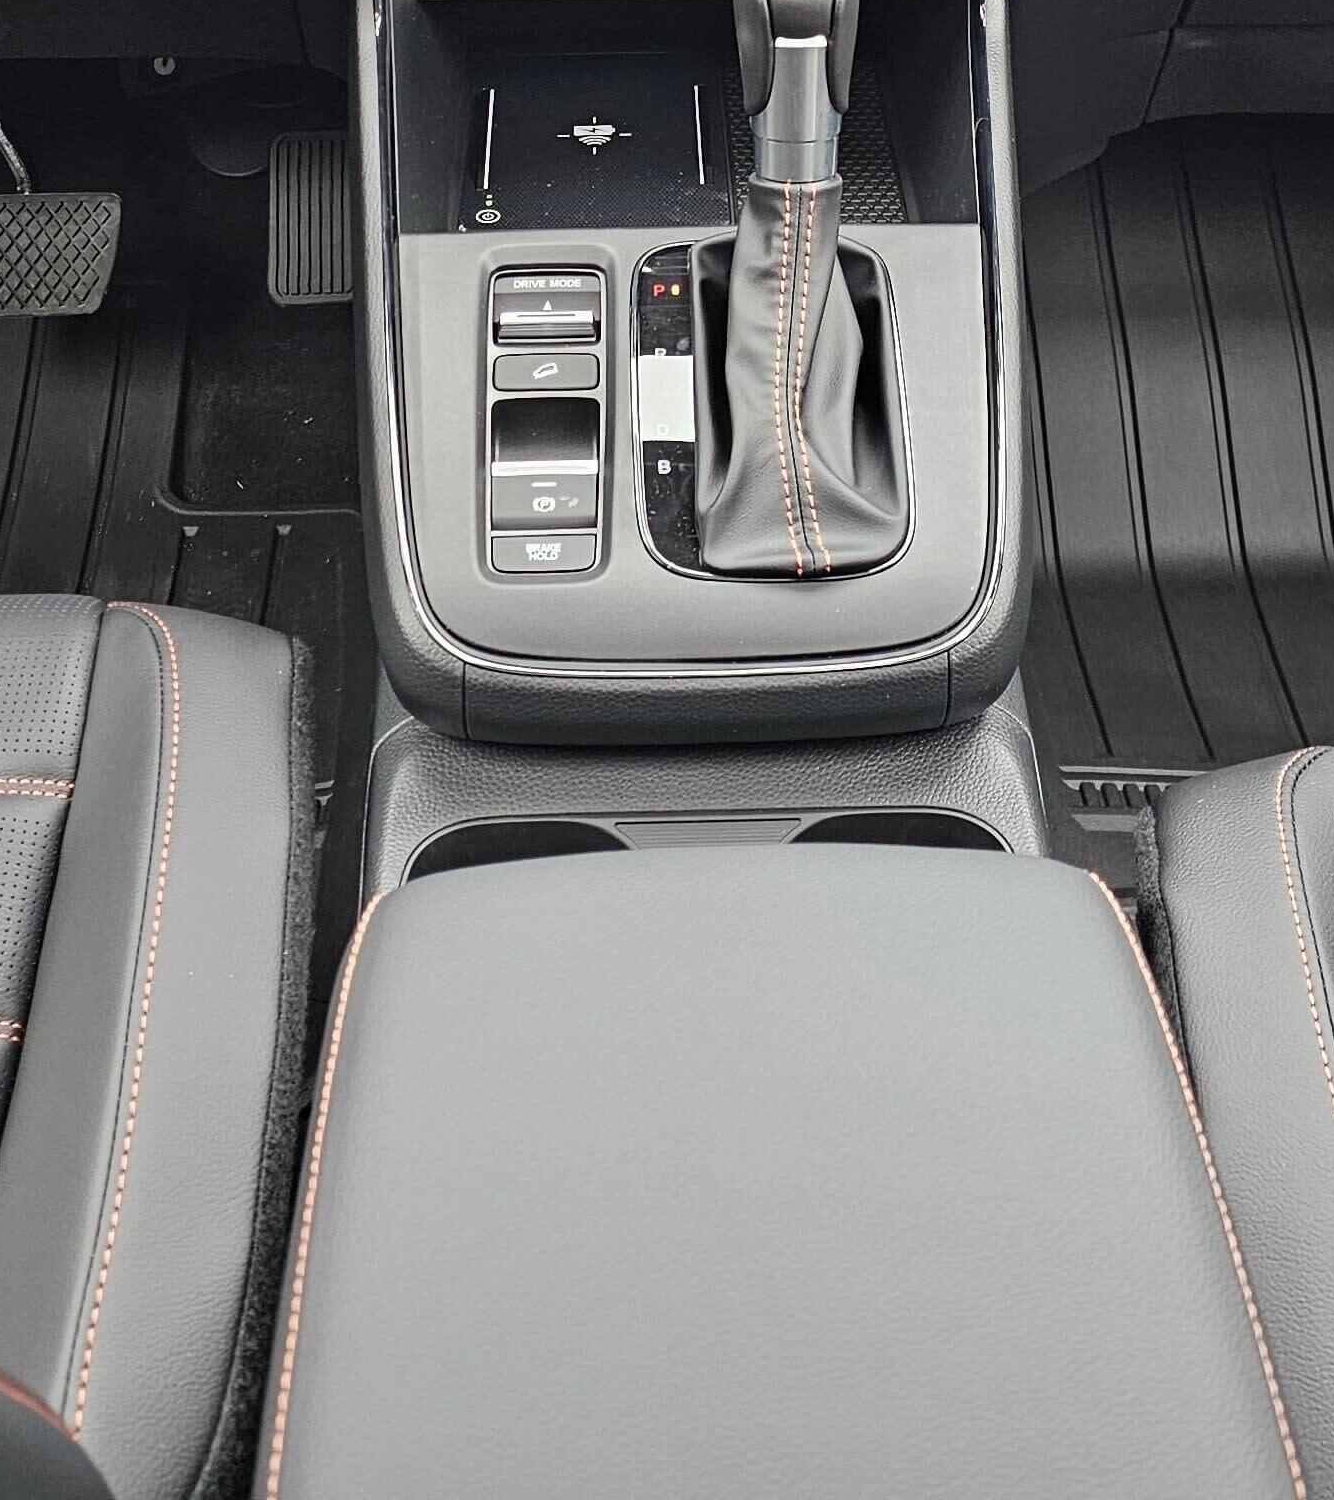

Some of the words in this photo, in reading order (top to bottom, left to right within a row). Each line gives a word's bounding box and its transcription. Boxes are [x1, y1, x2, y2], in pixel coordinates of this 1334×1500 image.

[513, 279, 546, 289] DRIVE
[549, 278, 582, 288] MODE
[653, 284, 666, 297] P
[657, 459, 672, 475] B
[526, 543, 561, 553] BRAKE
[528, 551, 559, 561] HOLD
